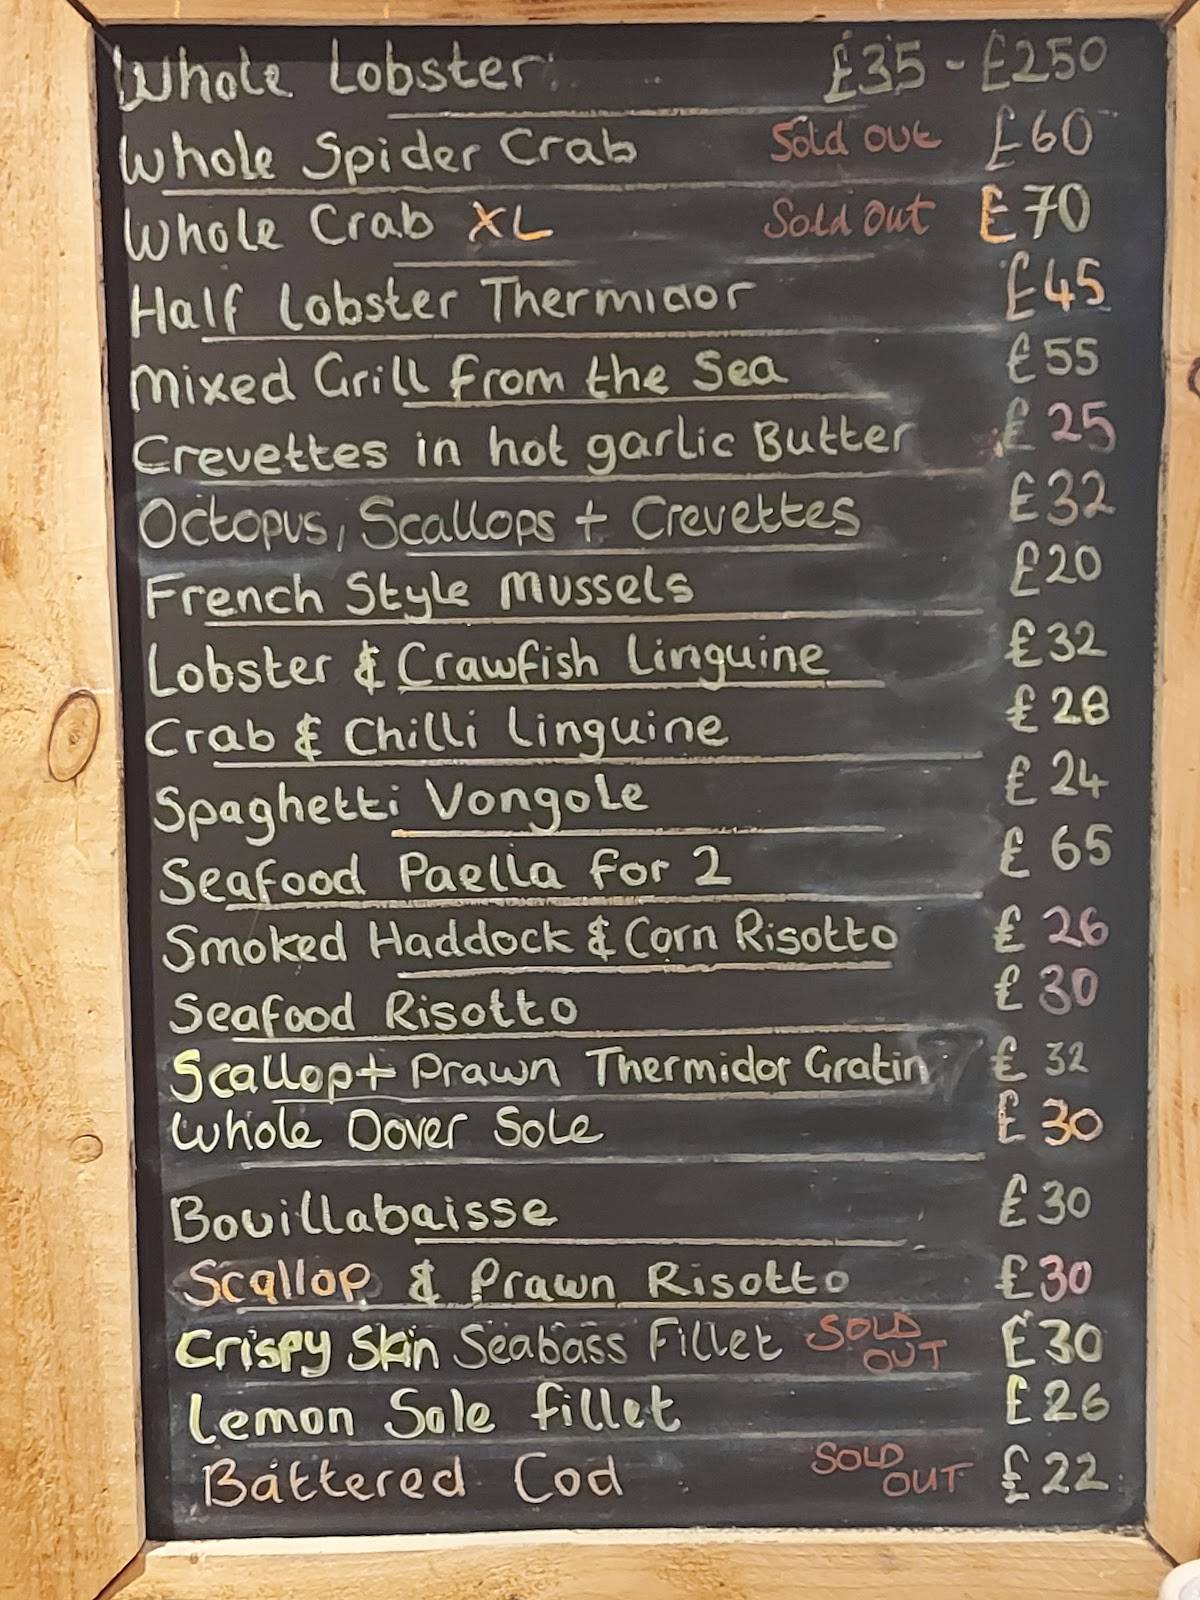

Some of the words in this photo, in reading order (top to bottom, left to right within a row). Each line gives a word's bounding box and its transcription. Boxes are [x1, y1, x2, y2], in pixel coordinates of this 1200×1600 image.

[113, 45, 294, 112] Whole
[329, 38, 544, 97] Lobster
[119, 129, 276, 185] Whole
[302, 129, 481, 185] Spider
[500, 126, 638, 165] Crab
[770, 115, 848, 162] Sold
[123, 206, 284, 262] Whole
[310, 200, 435, 244] Crab
[468, 200, 554, 242] XL
[763, 198, 852, 240] Sold
[129, 282, 244, 338] Half
[313, 350, 429, 396] Grill
[585, 352, 670, 400] the
[692, 348, 790, 394] Sea
[131, 432, 389, 477] Crevettes
[415, 431, 462, 469] in
[488, 423, 568, 469] hot
[586, 414, 737, 476] garlic
[753, 414, 914, 463] Butter
[359, 493, 556, 551] Scallops
[574, 498, 608, 543] +
[631, 491, 862, 542] Crevettes
[144, 571, 325, 620] French
[345, 569, 472, 624] Style
[149, 640, 334, 698] Lobster
[353, 639, 386, 696] &
[398, 639, 600, 686] Crawfish
[143, 716, 277, 758] Crab
[294, 711, 322, 763] &
[344, 707, 479, 756] Chilli
[152, 779, 401, 847] Spaghetti
[424, 772, 650, 834] Vongole
[158, 850, 367, 906] Seafood
[399, 846, 567, 892] Paella
[691, 844, 734, 887] 2
[161, 918, 348, 975] Smoked
[368, 917, 574, 961] Haddock
[587, 913, 617, 962] &
[624, 914, 719, 958] Corn
[734, 906, 900, 956] Risotto
[168, 989, 357, 1039] Seafood
[384, 986, 580, 1032] Risotto
[410, 1052, 562, 1090] Prawn
[584, 1042, 794, 1088] Thermidor
[803, 1042, 931, 1087] Gratin
[170, 1108, 324, 1153] Whole
[347, 1107, 470, 1152] Dover
[493, 1105, 607, 1150] Sole
[169, 1188, 560, 1246] Bouillabaisse
[181, 1257, 374, 1308] Scallop
[408, 1258, 441, 1304] &
[469, 1256, 617, 1303] Prawn
[647, 1258, 851, 1299] Risotto
[347, 1323, 441, 1372] Skin
[453, 1323, 629, 1370] Seabass
[648, 1315, 784, 1363] Fillet
[805, 1313, 923, 1352] SOLD
[862, 1338, 949, 1375] OUT
[384, 1386, 497, 1440] Sole
[202, 1456, 467, 1507] Battered
[513, 1450, 625, 1504] Cod
[810, 1440, 905, 1476] SOLD
[881, 1461, 975, 1499] OUT
